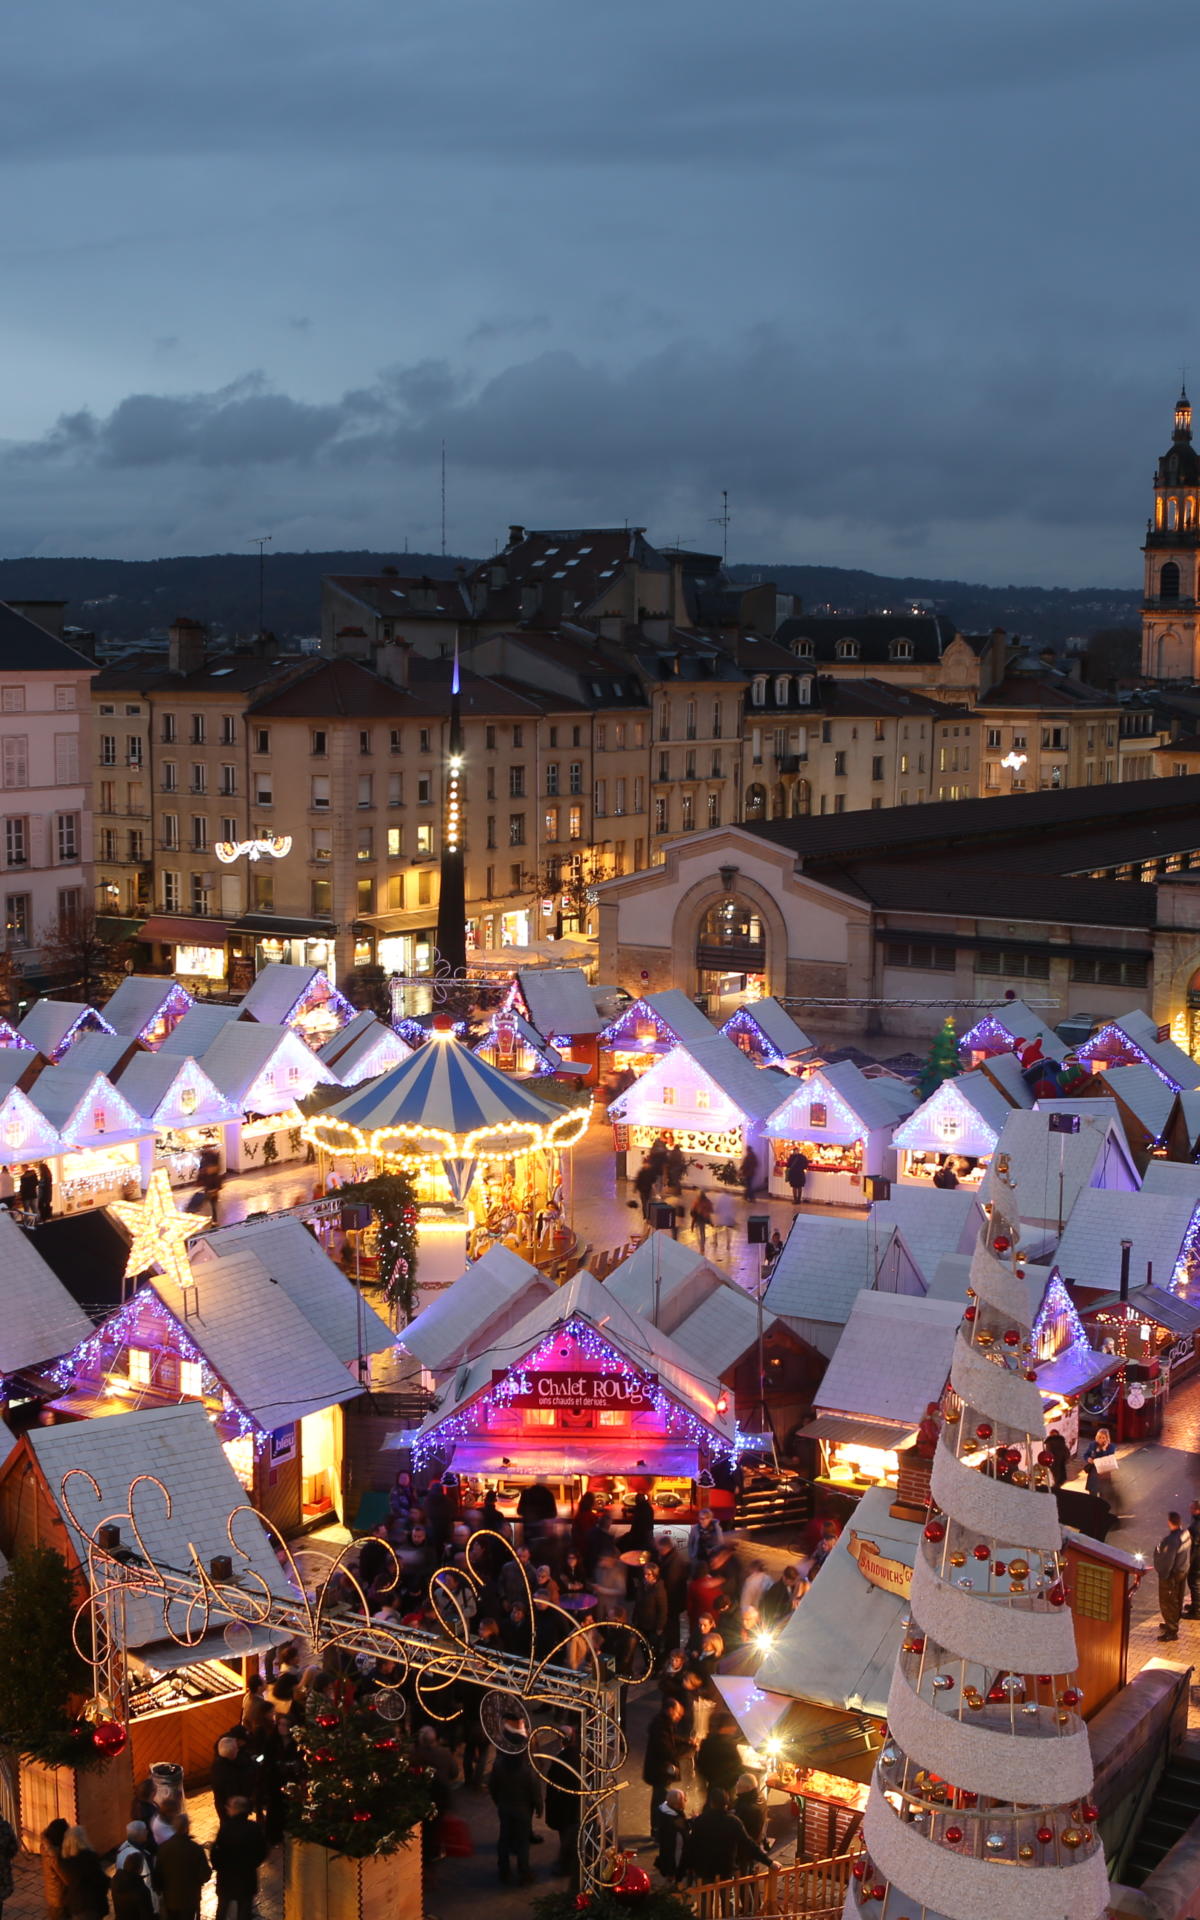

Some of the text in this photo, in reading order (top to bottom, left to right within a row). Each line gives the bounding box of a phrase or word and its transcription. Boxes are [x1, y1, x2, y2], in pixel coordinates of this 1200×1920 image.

[552, 1396, 575, 1406] chauds
[575, 1396, 582, 1406] et
[860, 1556, 904, 1585] SANDWICHS
